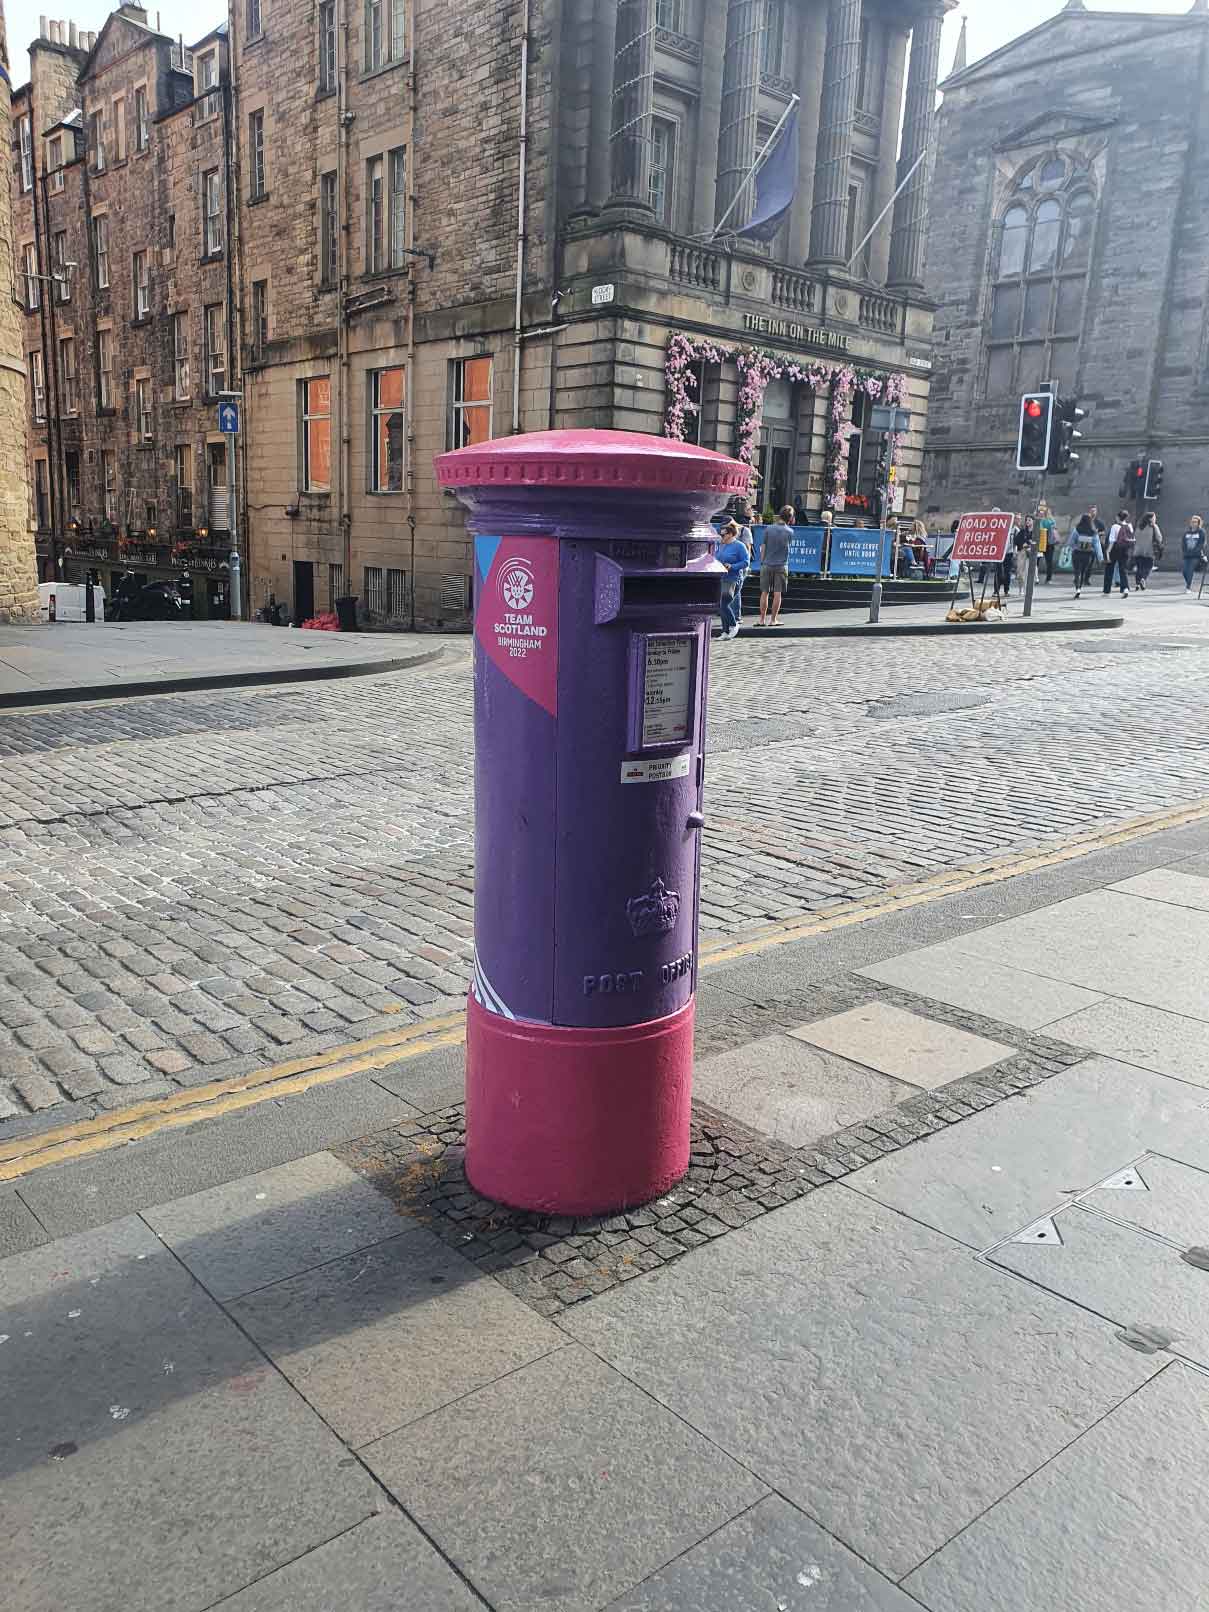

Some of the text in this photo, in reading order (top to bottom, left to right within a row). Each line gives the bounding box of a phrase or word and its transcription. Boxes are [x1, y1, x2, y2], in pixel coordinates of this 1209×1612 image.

[744, 313, 850, 349] THE INN ON THE MILE
[960, 518, 1008, 529] ROAD ON
[963, 531, 996, 542] RIGHT
[957, 544, 997, 556] CLOSED
[504, 613, 533, 625] TEAM
[494, 622, 547, 637] SCOTLAND
[497, 636, 542, 649] BIRMINGHAM
[509, 647, 527, 658] 2022
[583, 970, 643, 996] POST
